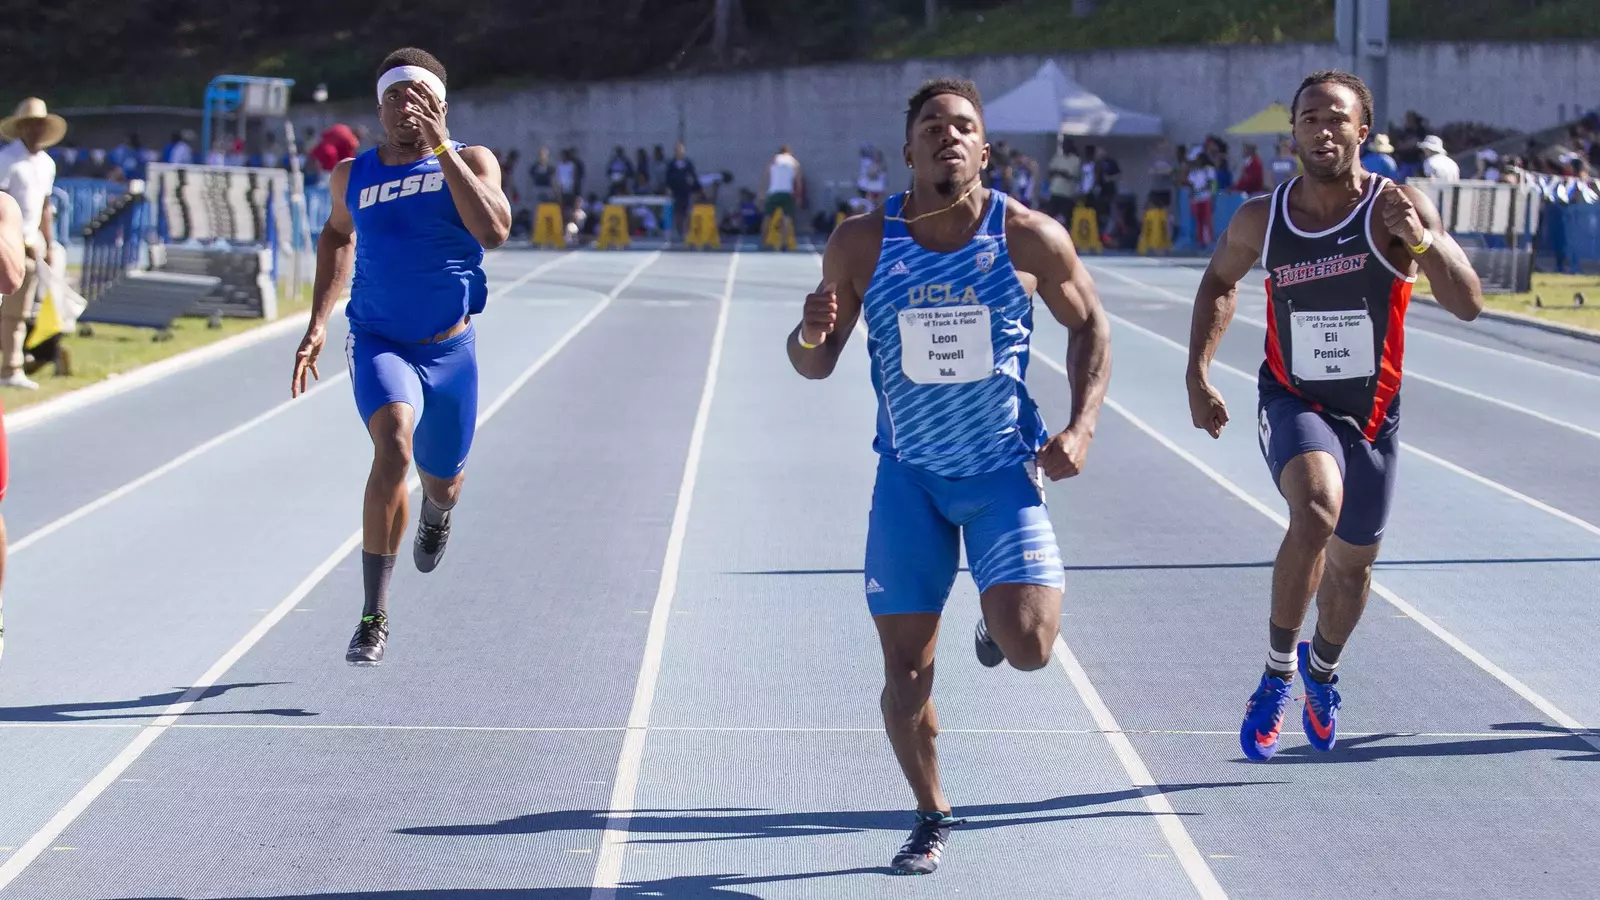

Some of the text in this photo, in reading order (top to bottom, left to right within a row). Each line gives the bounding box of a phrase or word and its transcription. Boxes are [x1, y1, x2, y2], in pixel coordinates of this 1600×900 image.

[359, 172, 445, 210] UCSB
[1294, 253, 1344, 268] CAL STATE
[1278, 256, 1364, 285] FULLERTON
[908, 283, 980, 305] UCLA
[934, 311, 953, 319] Bruin
[954, 310, 983, 319] Legends
[931, 333, 958, 344] Leon
[1325, 332, 1338, 343] Eli
[928, 349, 965, 361] Powell
[1313, 347, 1351, 359] Penick
